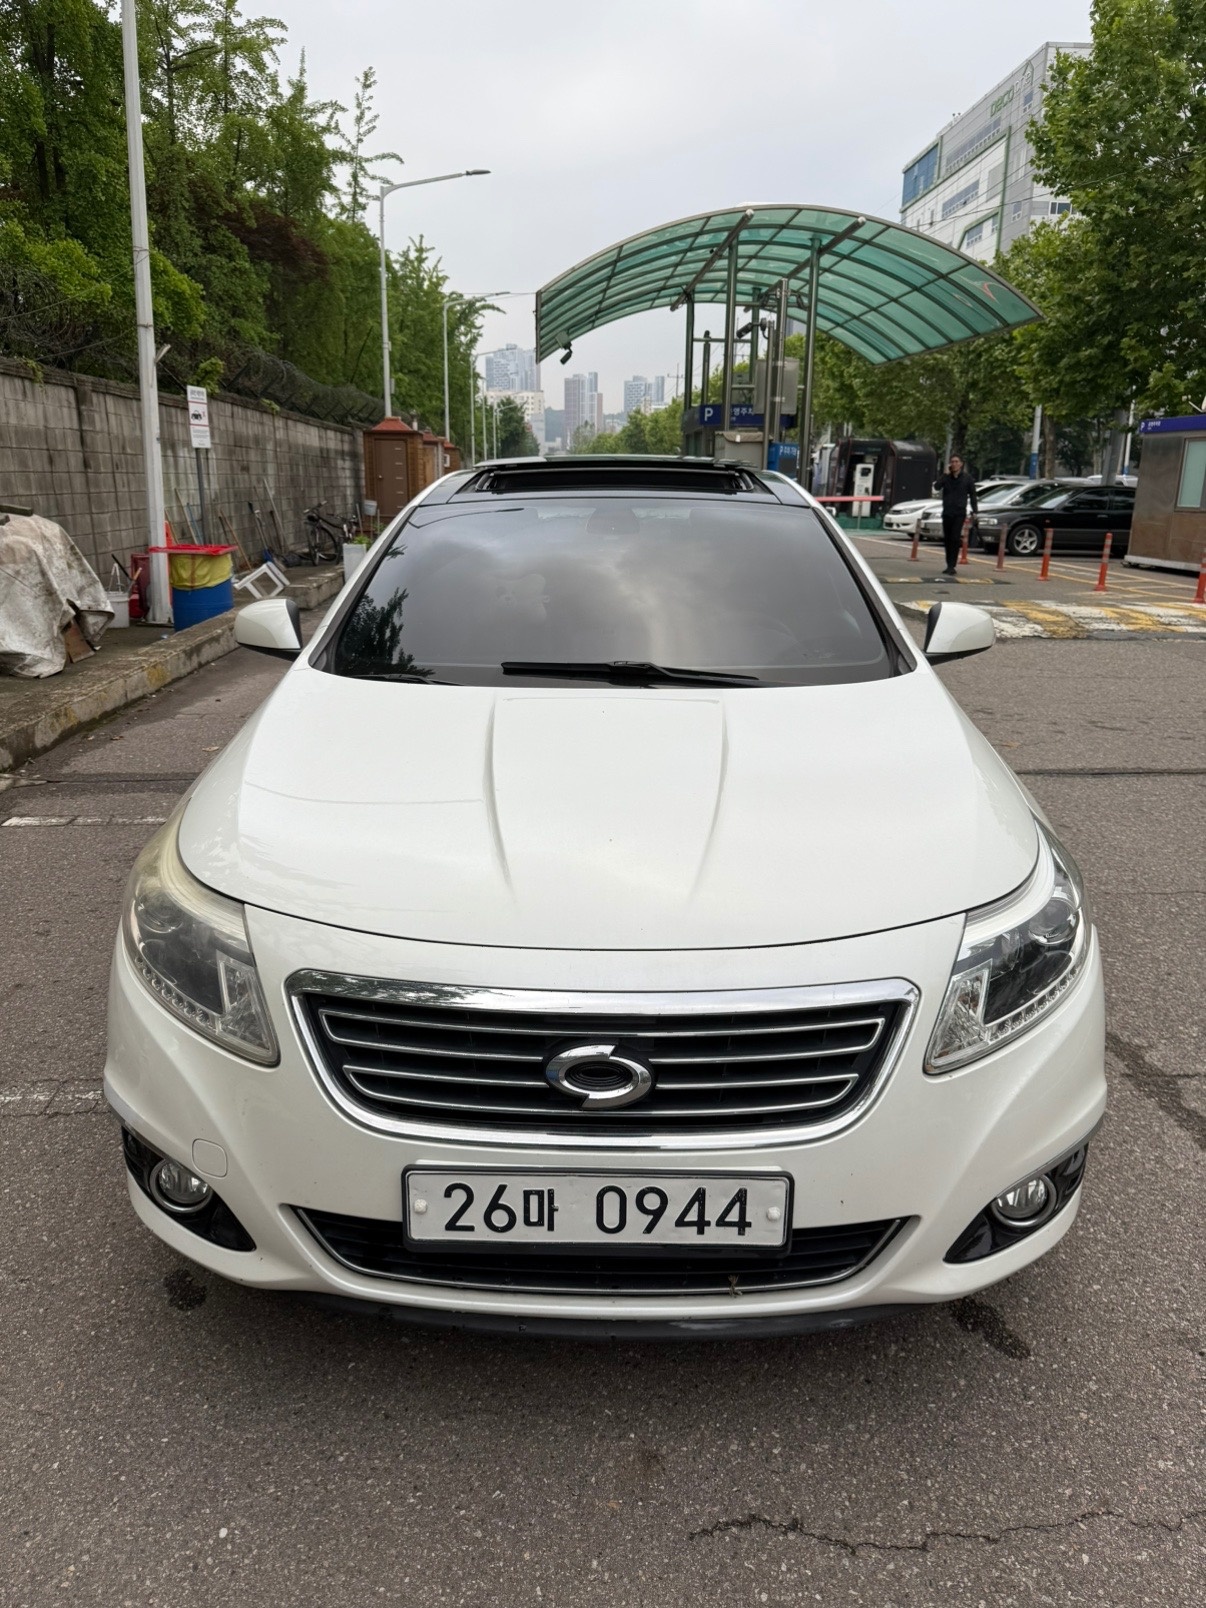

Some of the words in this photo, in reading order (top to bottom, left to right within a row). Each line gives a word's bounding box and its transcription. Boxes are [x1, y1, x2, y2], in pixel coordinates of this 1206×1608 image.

[704, 407, 713, 421] P
[443, 1182, 559, 1233] 26마
[595, 1184, 752, 1236] 0944
